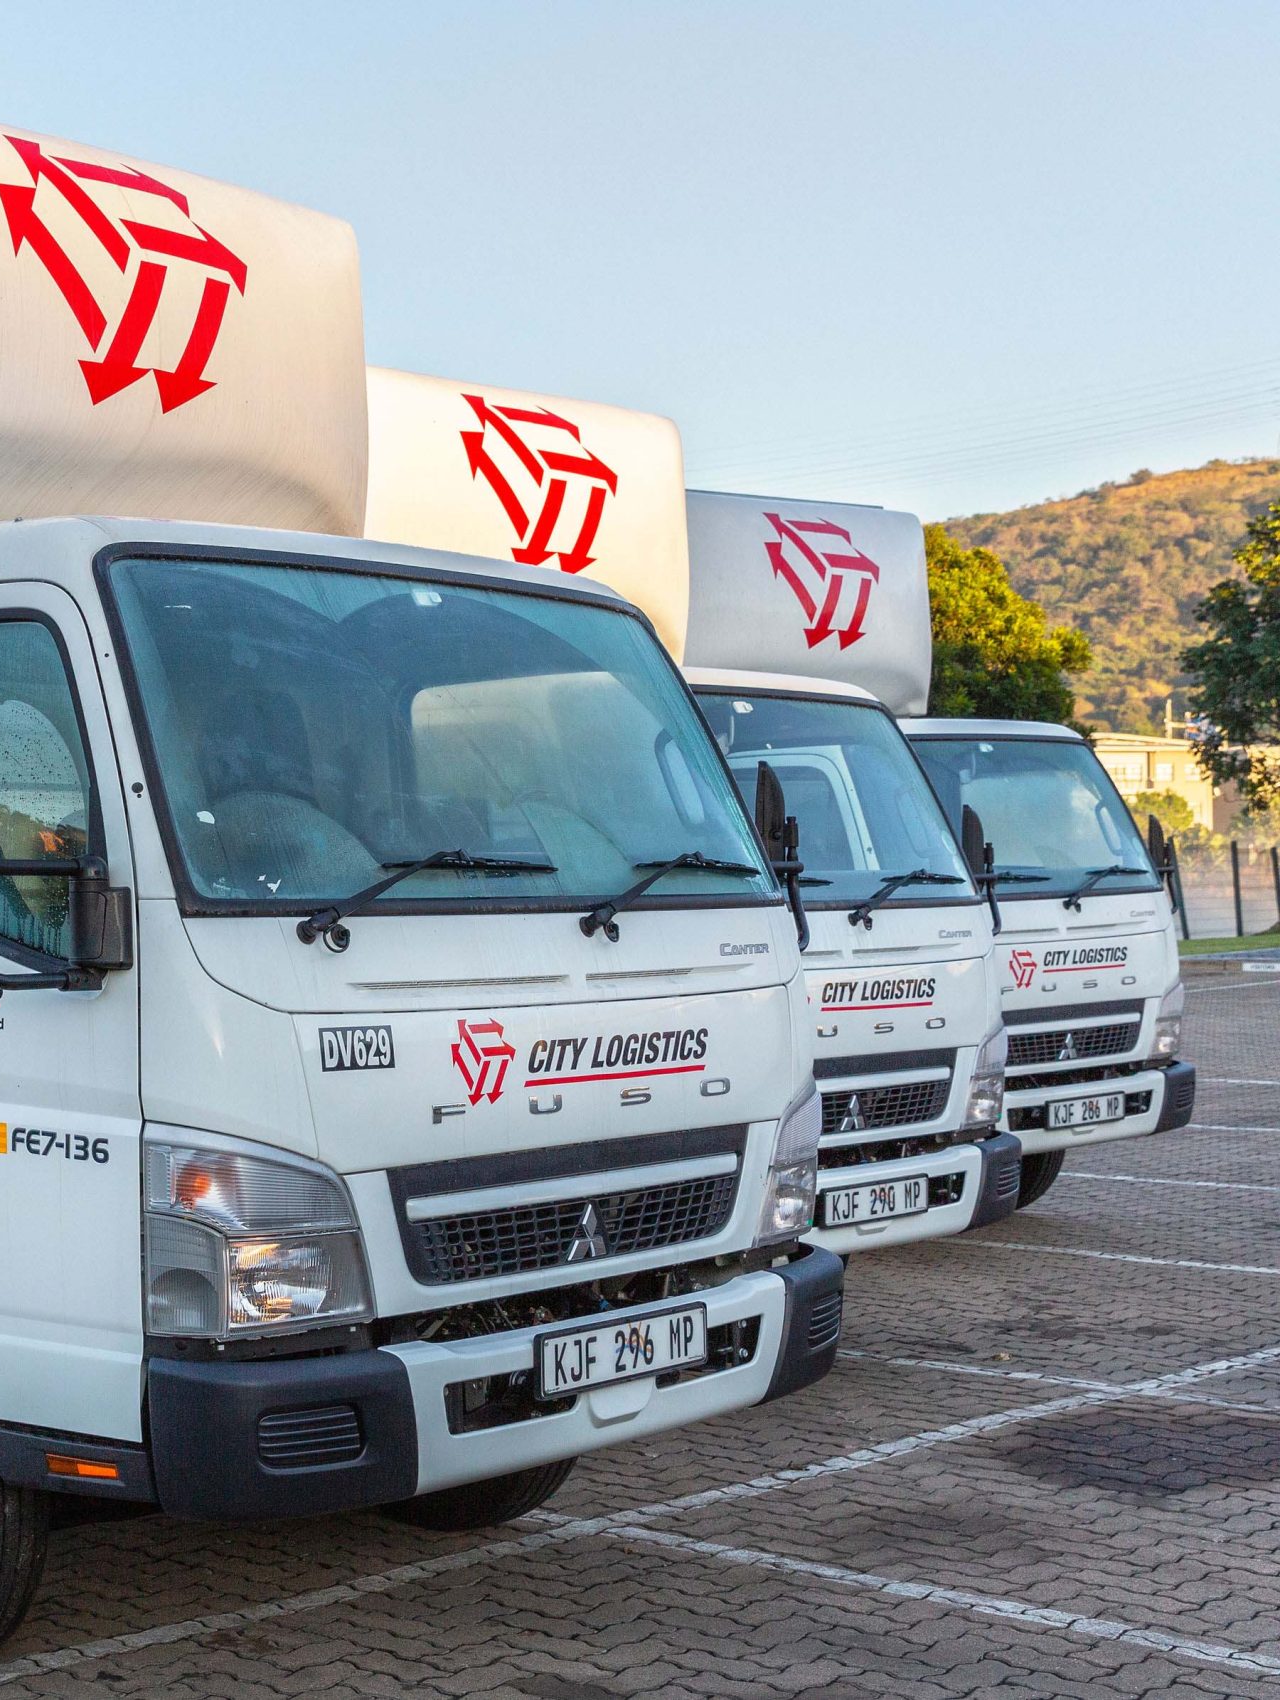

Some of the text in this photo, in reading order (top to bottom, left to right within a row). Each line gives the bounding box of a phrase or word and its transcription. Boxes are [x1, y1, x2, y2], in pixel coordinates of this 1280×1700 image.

[1043, 946, 1128, 967] CITY LOGISTICS
[821, 977, 936, 1004] CITY LOGISTICS
[1000, 975, 1137, 996] FUSO
[816, 1017, 946, 1038] USO
[321, 1028, 392, 1069] DV629
[527, 1027, 709, 1074] CITY LOGISTICS
[432, 1076, 731, 1125] FUSO
[1054, 1096, 1119, 1125] KJF 286 MP
[11, 1127, 110, 1164] FE7-136
[832, 1181, 921, 1222] KJF 290 MP
[554, 1315, 694, 1386] KJF 296 MP
